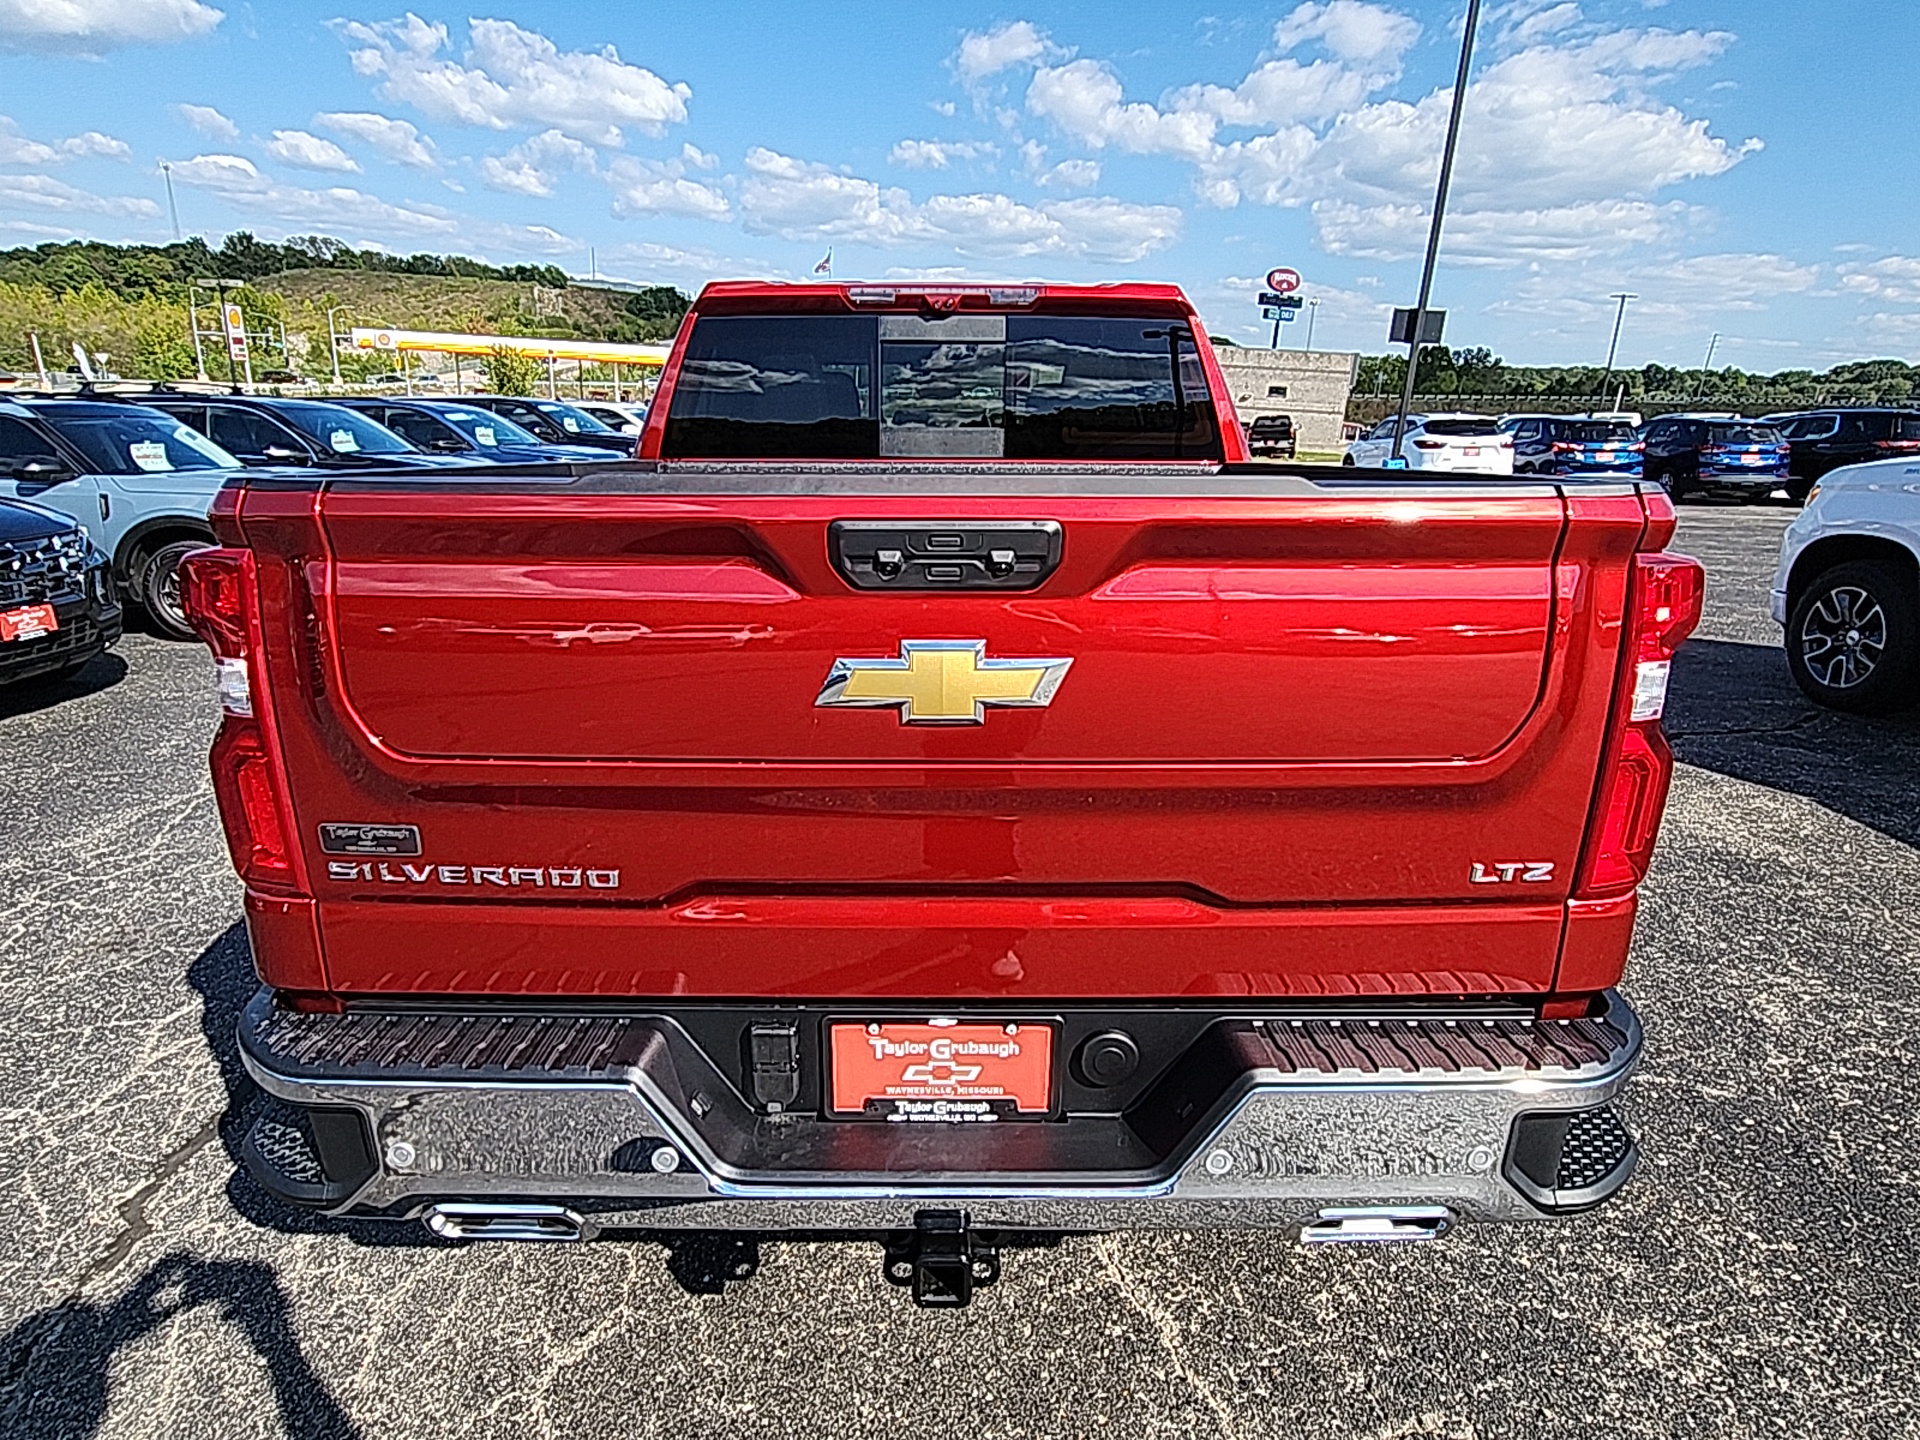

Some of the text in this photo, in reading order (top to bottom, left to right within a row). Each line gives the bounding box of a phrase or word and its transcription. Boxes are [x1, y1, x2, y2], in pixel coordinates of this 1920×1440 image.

[328, 861, 619, 888] SILVERADO
[1471, 861, 1555, 882] LTZ
[868, 1038, 1020, 1059] Taylor Grubaugh
[957, 1086, 1004, 1095] MISSOURI
[895, 1100, 991, 1114] Taylor Grubaugh
